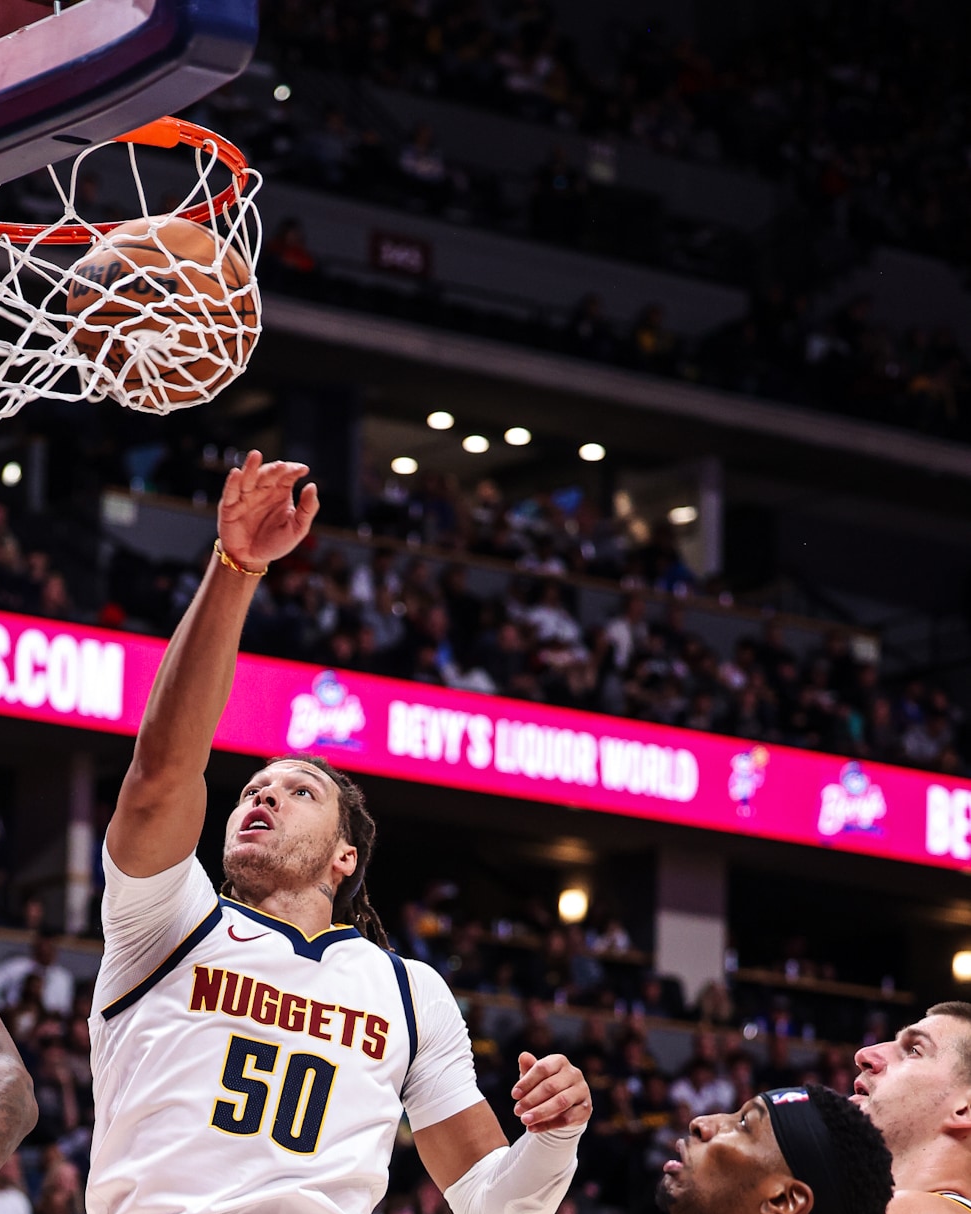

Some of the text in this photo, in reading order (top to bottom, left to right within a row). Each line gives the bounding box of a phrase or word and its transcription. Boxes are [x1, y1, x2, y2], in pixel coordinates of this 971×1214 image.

[387, 700, 699, 802] BEVY'S LIQUOR WORLD
[189, 964, 390, 1060] NUGGETS
[208, 1032, 340, 1155] 50
